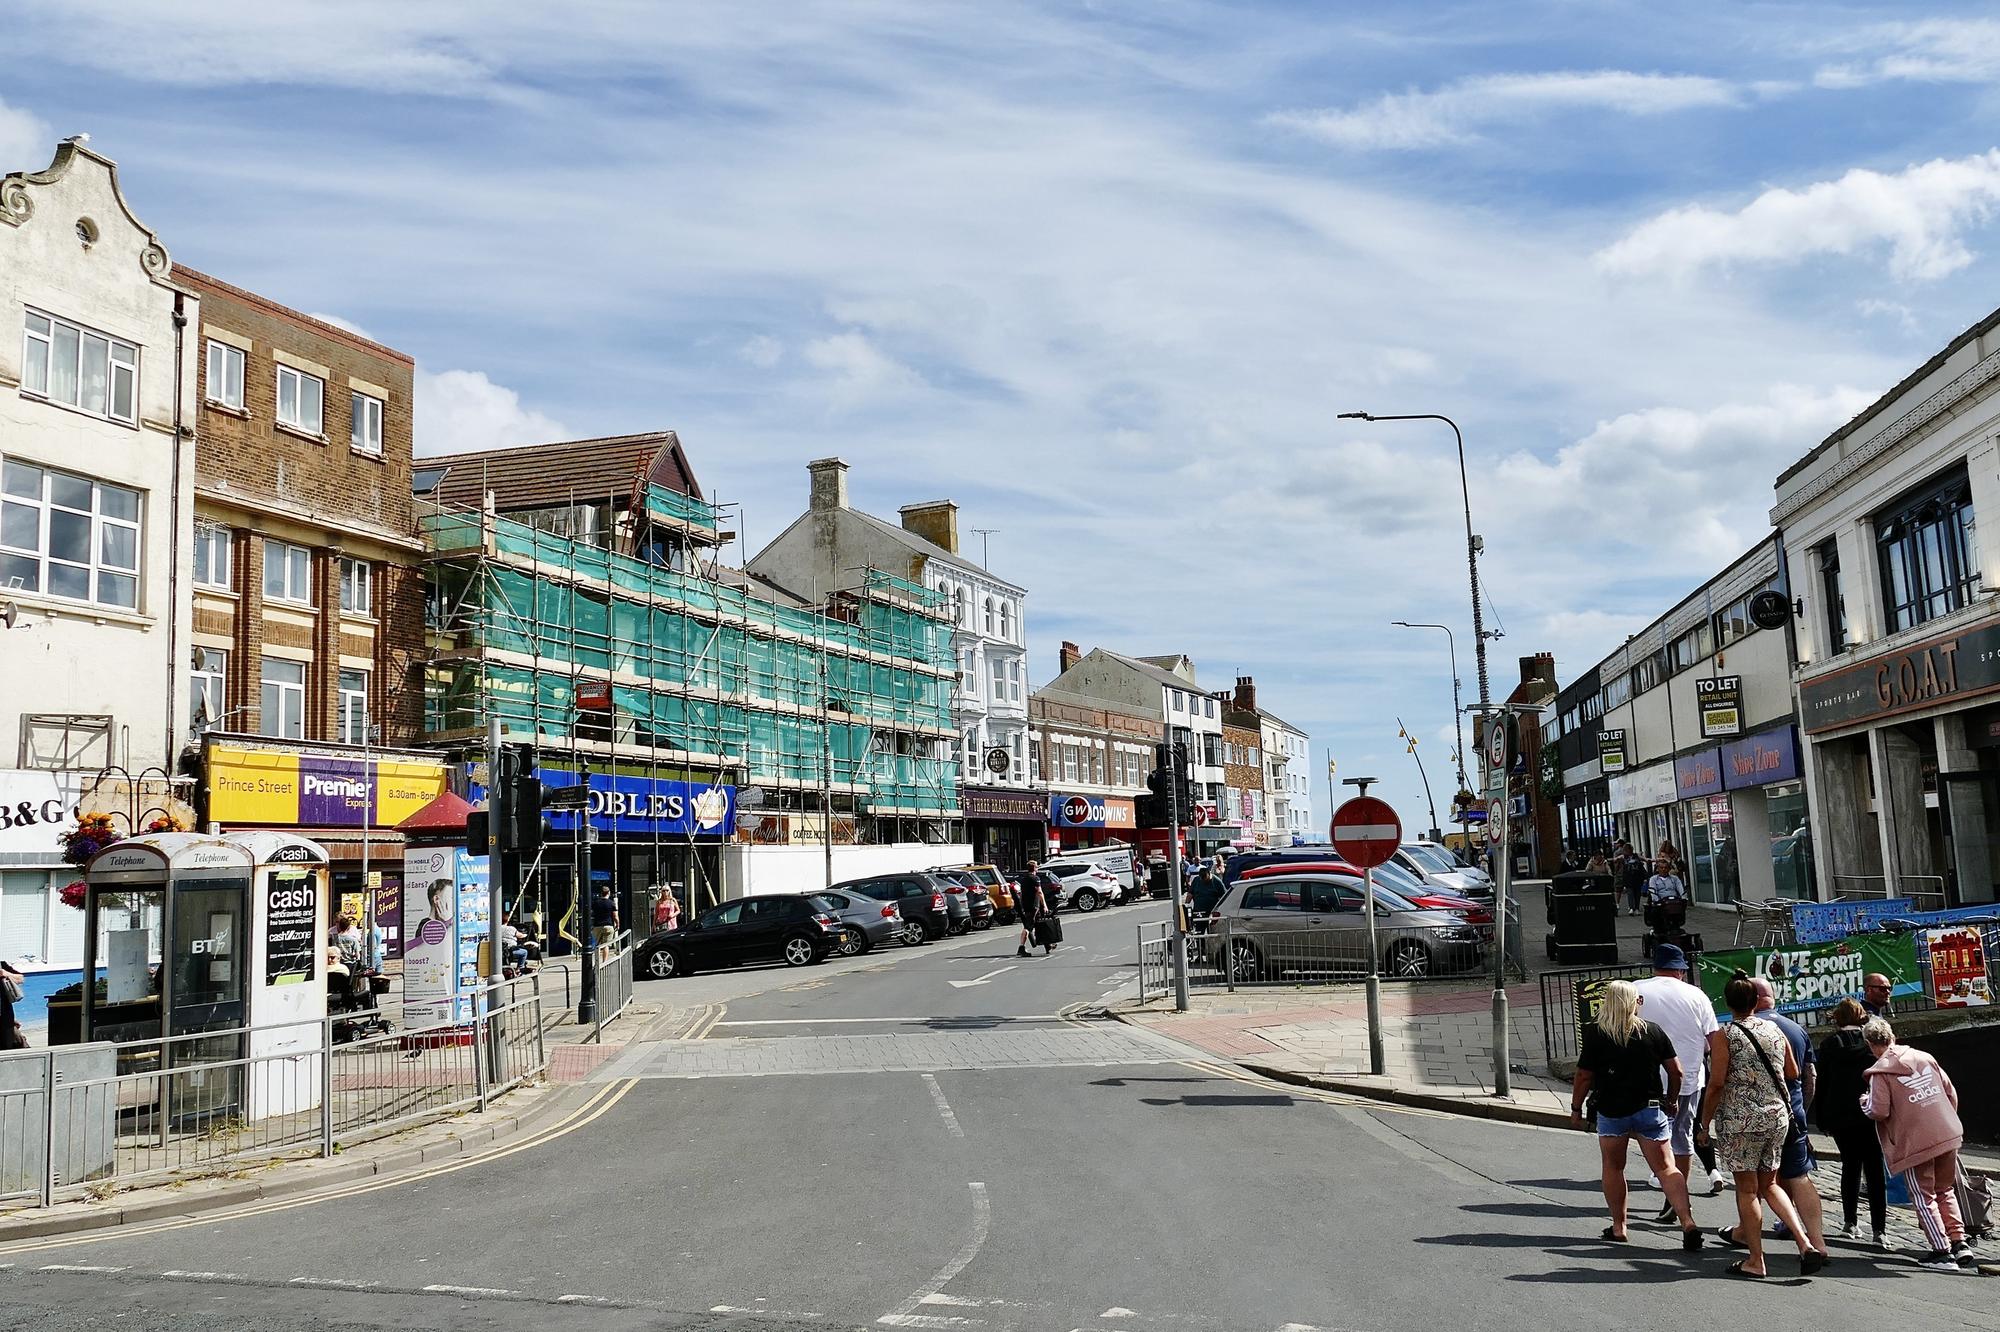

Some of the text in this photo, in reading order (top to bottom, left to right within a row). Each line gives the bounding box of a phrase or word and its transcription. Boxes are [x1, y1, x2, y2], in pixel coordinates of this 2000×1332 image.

[1697, 677, 1738, 693] TO LET
[1700, 691, 1737, 702] RETAIL UNIT
[1598, 730, 1623, 741] TO LET
[218, 777, 293, 795] Prince Street
[345, 798, 372, 810] Expres
[588, 789, 683, 819] OBLES
[792, 829, 814, 839] COFEE
[194, 853, 230, 864] Telephone
[281, 847, 308, 861] cash
[110, 856, 146, 868] Telephone
[411, 880, 429, 889] Ears?
[269, 884, 315, 909] cash
[377, 886, 399, 902] Prince
[269, 908, 314, 919] withdrawals and
[377, 897, 399, 916] Street
[191, 938, 217, 955] BT
[408, 957, 430, 966] boost?
[1755, 950, 1863, 981] LOVE SPORT?
[1795, 969, 1864, 1001] SPORT!
[1777, 1003, 1792, 1012] ALL
[1793, 1001, 1809, 1011] THE
[1809, 999, 1824, 1008] LIVE
[1908, 1085, 1941, 1103] adidas
